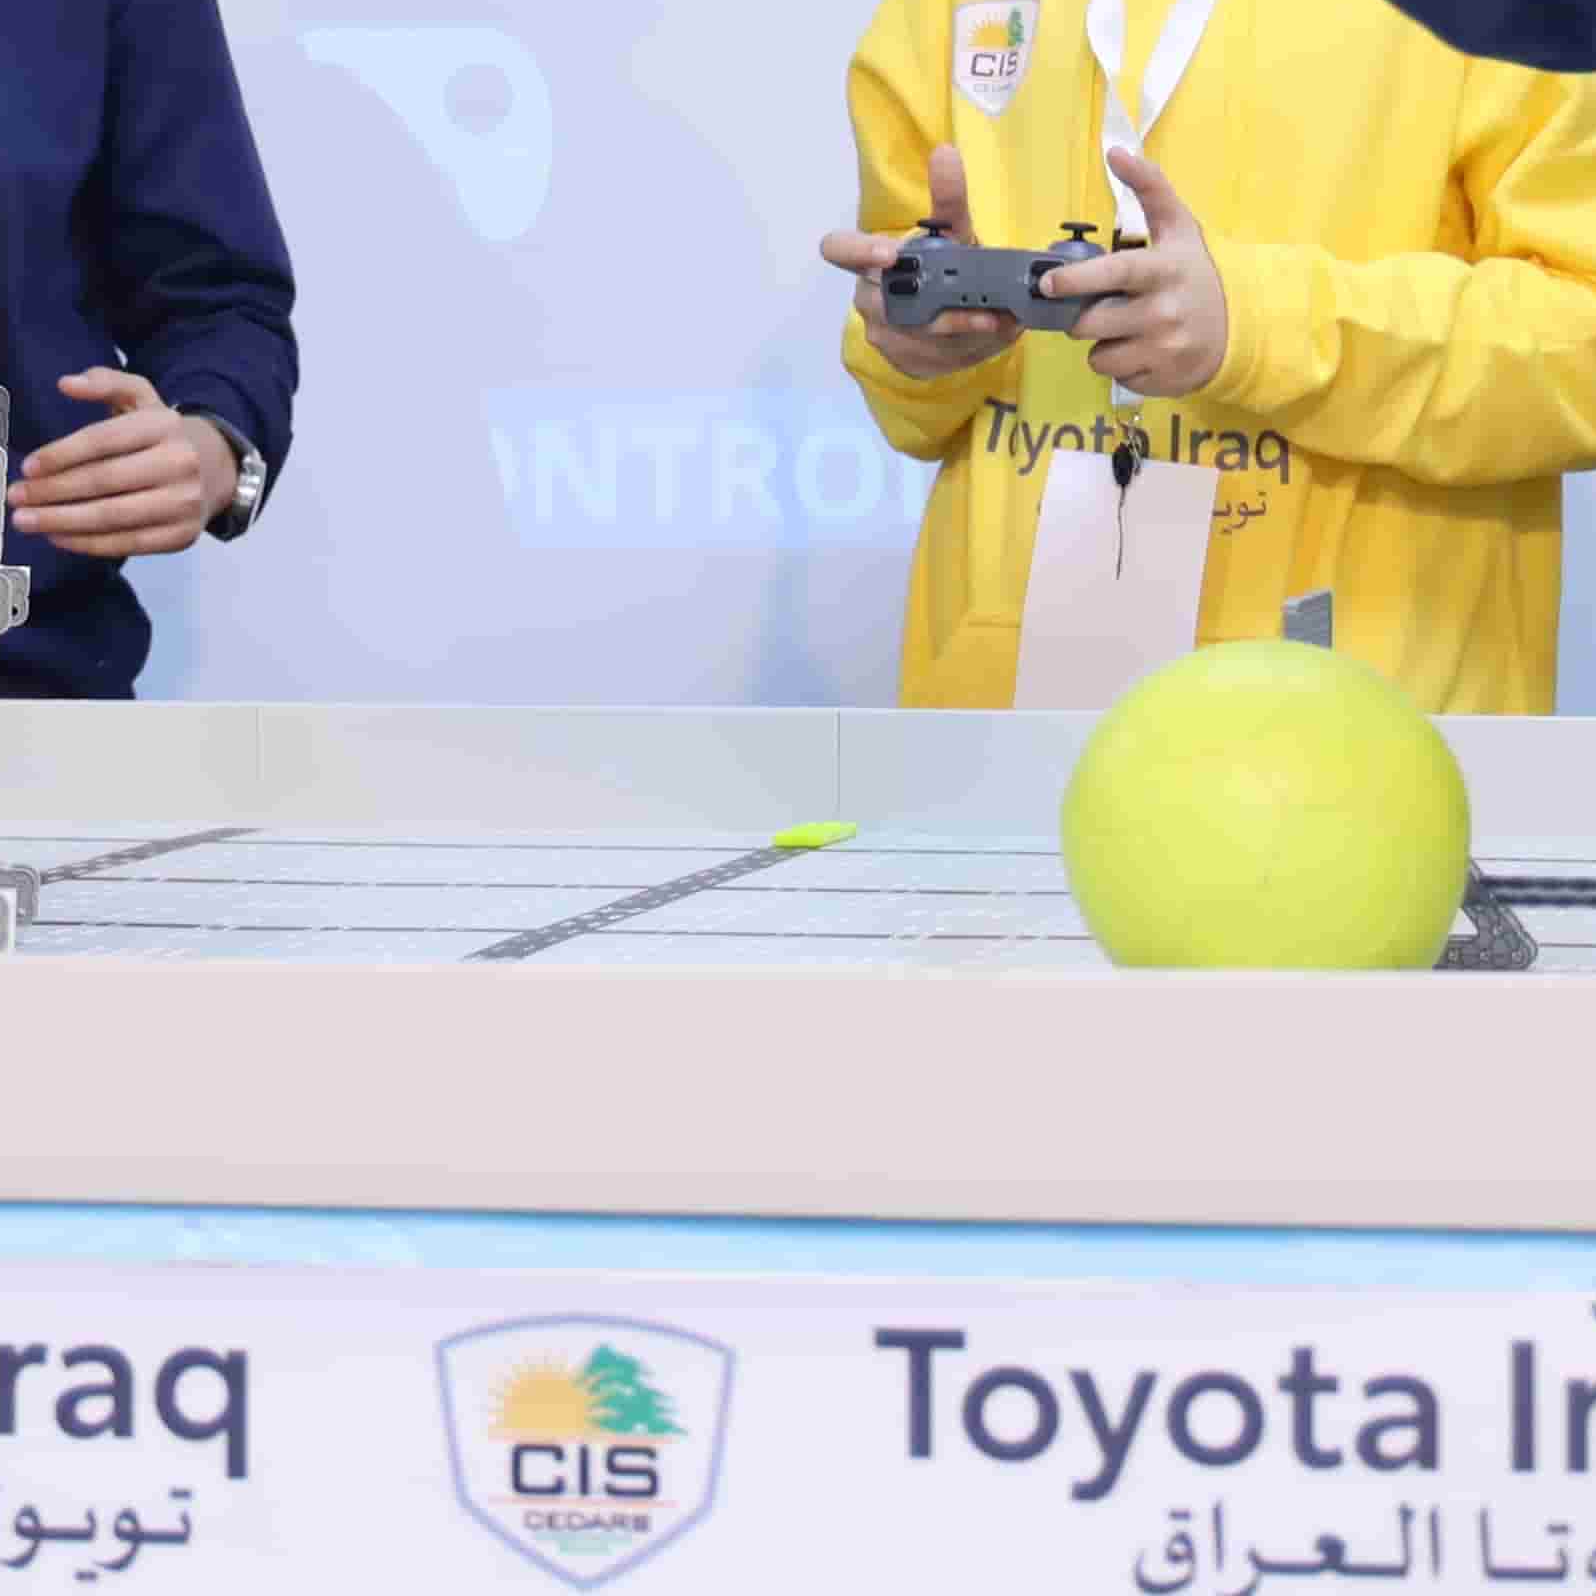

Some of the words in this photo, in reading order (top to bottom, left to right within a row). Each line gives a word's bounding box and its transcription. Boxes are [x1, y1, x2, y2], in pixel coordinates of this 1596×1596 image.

[1169, 412, 1292, 486] Iraq
[872, 1326, 1444, 1504] Toyota
[509, 1441, 662, 1501] CIS
